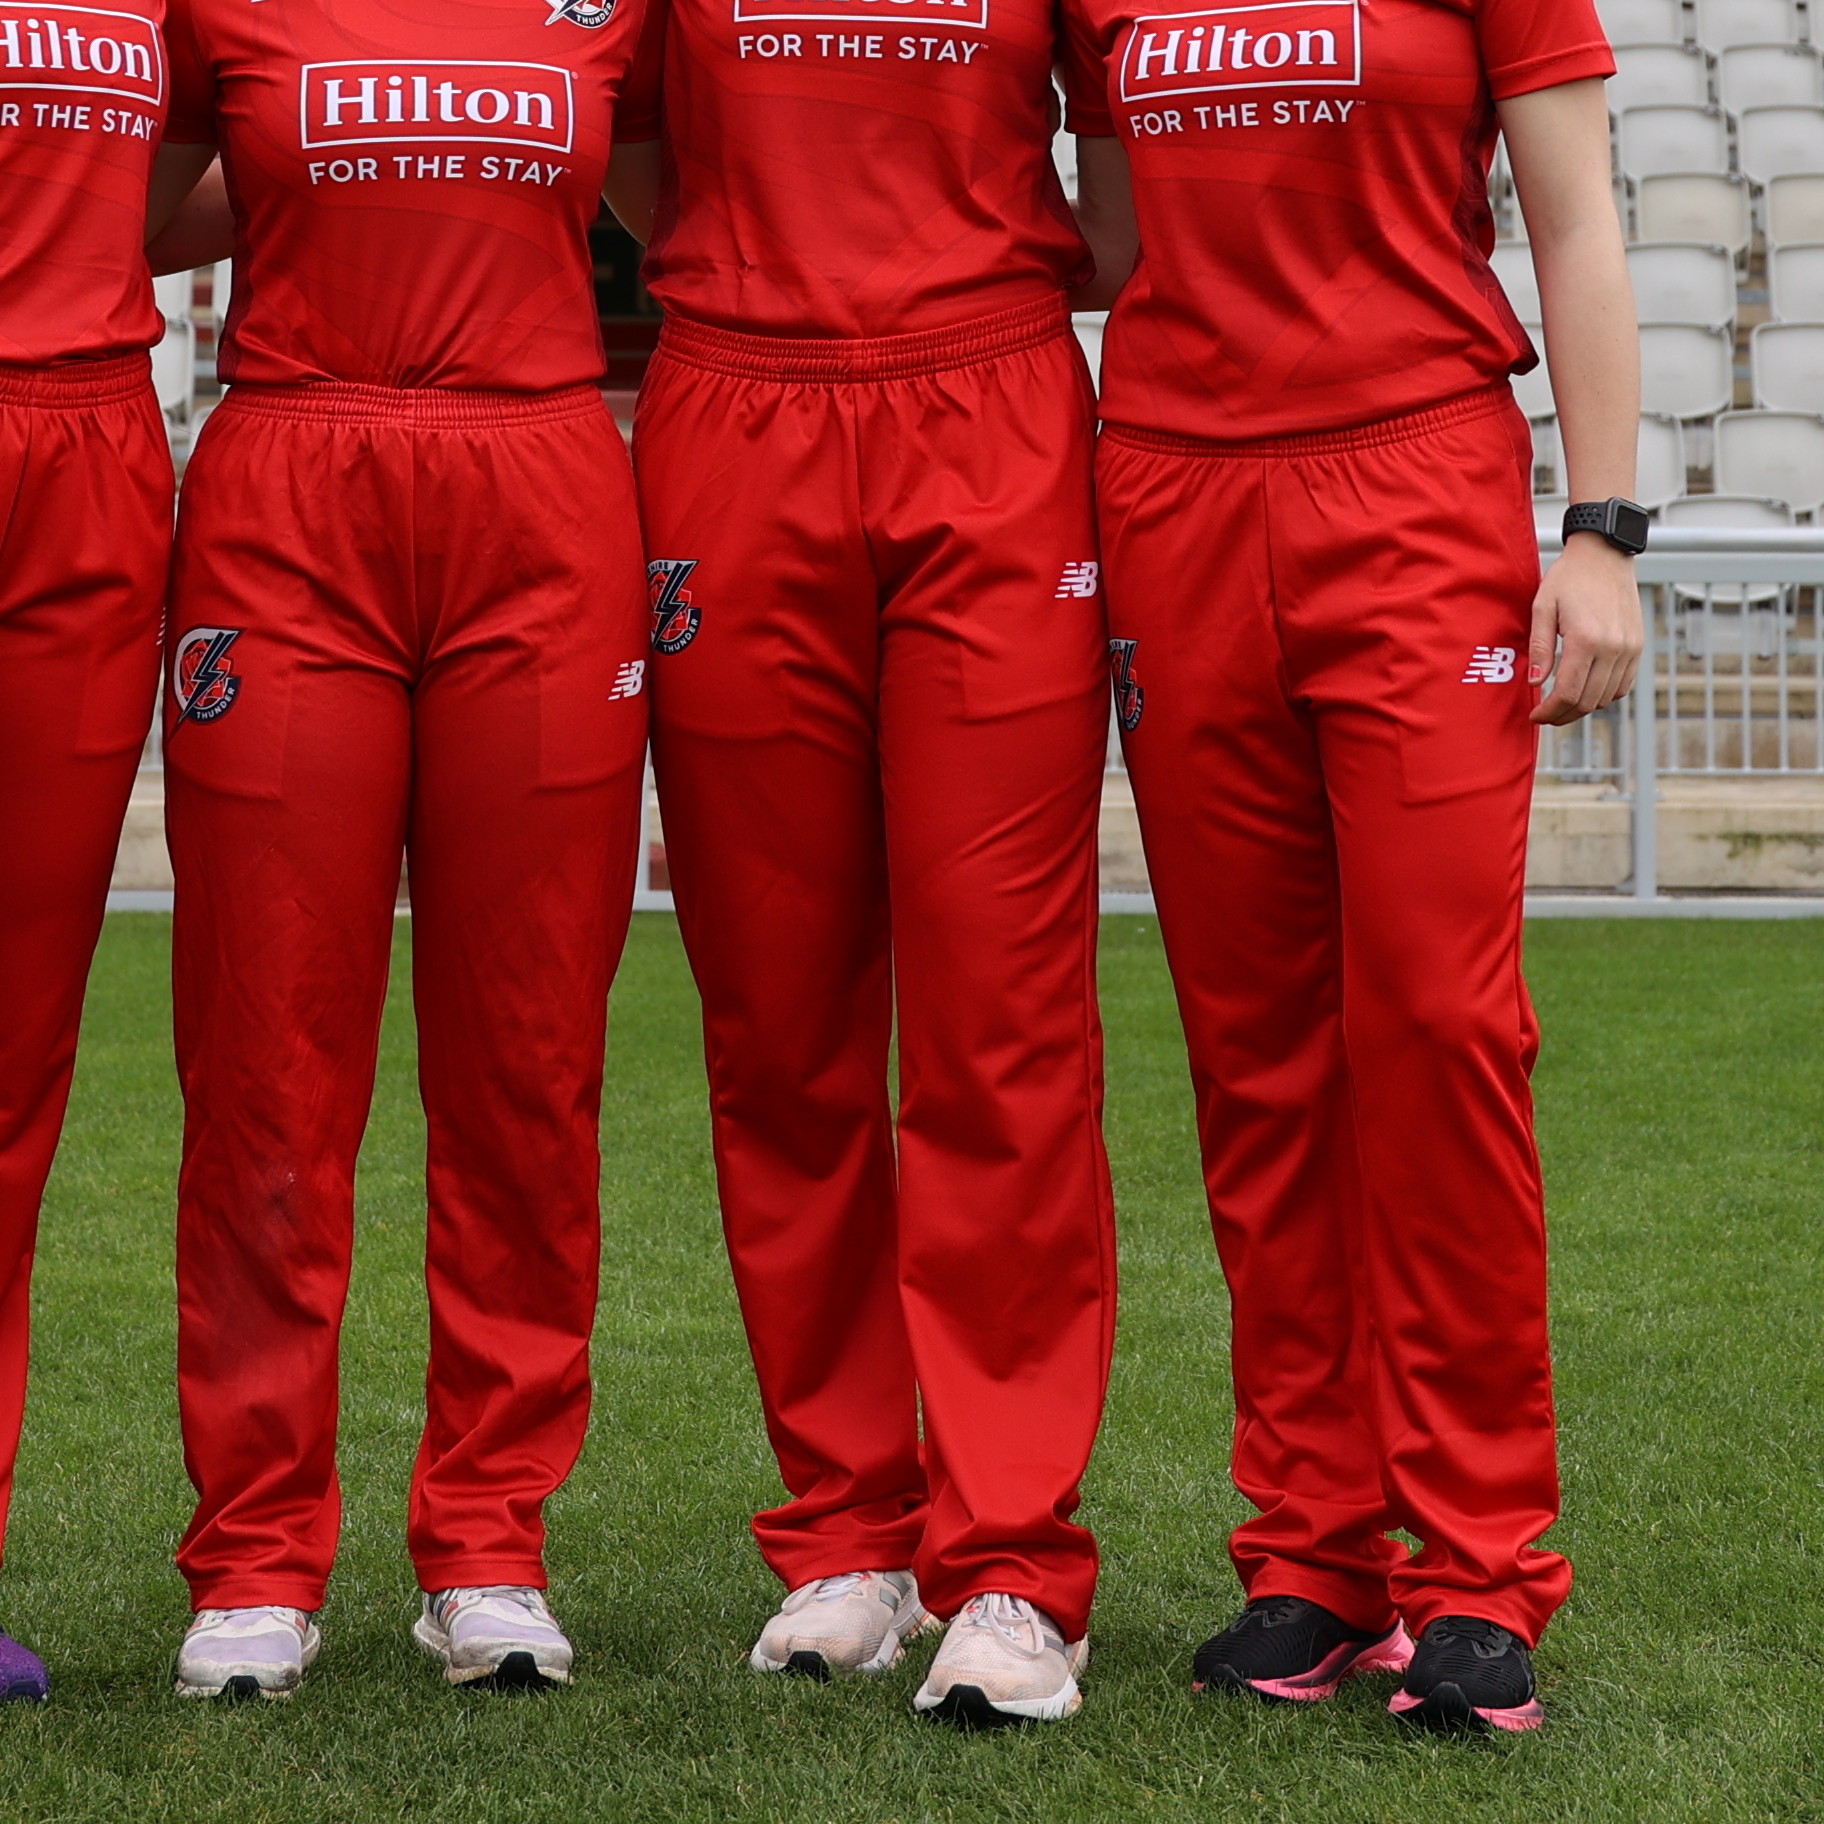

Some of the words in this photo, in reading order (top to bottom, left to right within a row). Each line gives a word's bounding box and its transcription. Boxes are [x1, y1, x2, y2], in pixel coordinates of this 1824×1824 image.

[575, 2, 613, 25] THUNDER
[738, 34, 803, 59] FOR
[816, 33, 883, 59] THE
[1134, 24, 1338, 82] Hilton
[32, 103, 91, 131] THE
[322, 75, 555, 131] Hilton
[1129, 108, 1185, 139] FOR
[1193, 101, 1260, 130] THE
[308, 156, 379, 186] FOR
[392, 155, 466, 180] THE
[663, 618, 699, 653] THUNDER
[196, 686, 236, 720] THUNDER
